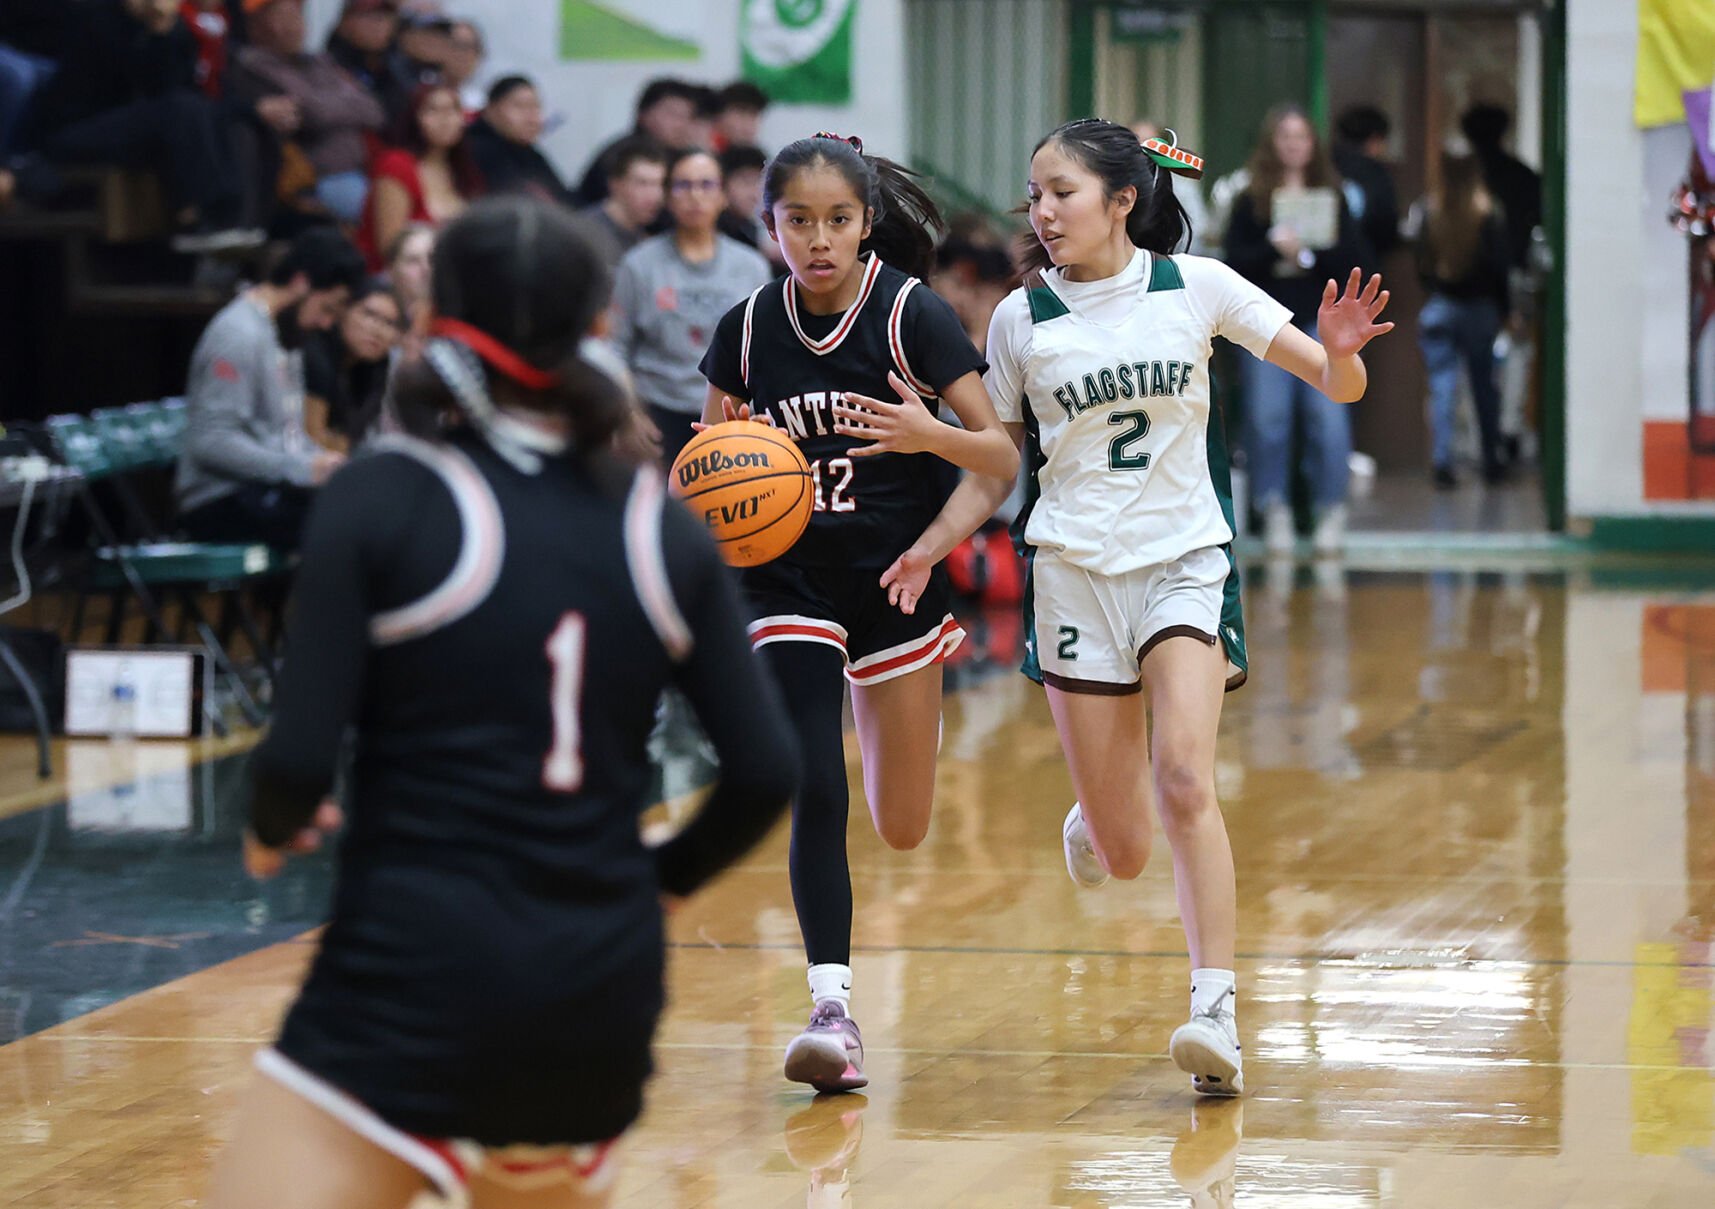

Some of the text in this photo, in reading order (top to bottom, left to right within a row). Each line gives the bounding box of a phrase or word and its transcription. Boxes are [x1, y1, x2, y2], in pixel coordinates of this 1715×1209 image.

[1053, 360, 1194, 422] FLAGSTAFF
[1107, 409, 1152, 472] 2
[678, 450, 769, 487] Wilson
[811, 458, 856, 512] 12
[705, 496, 758, 529] EVO
[1057, 625, 1080, 661] 2
[543, 609, 587, 794] 1
